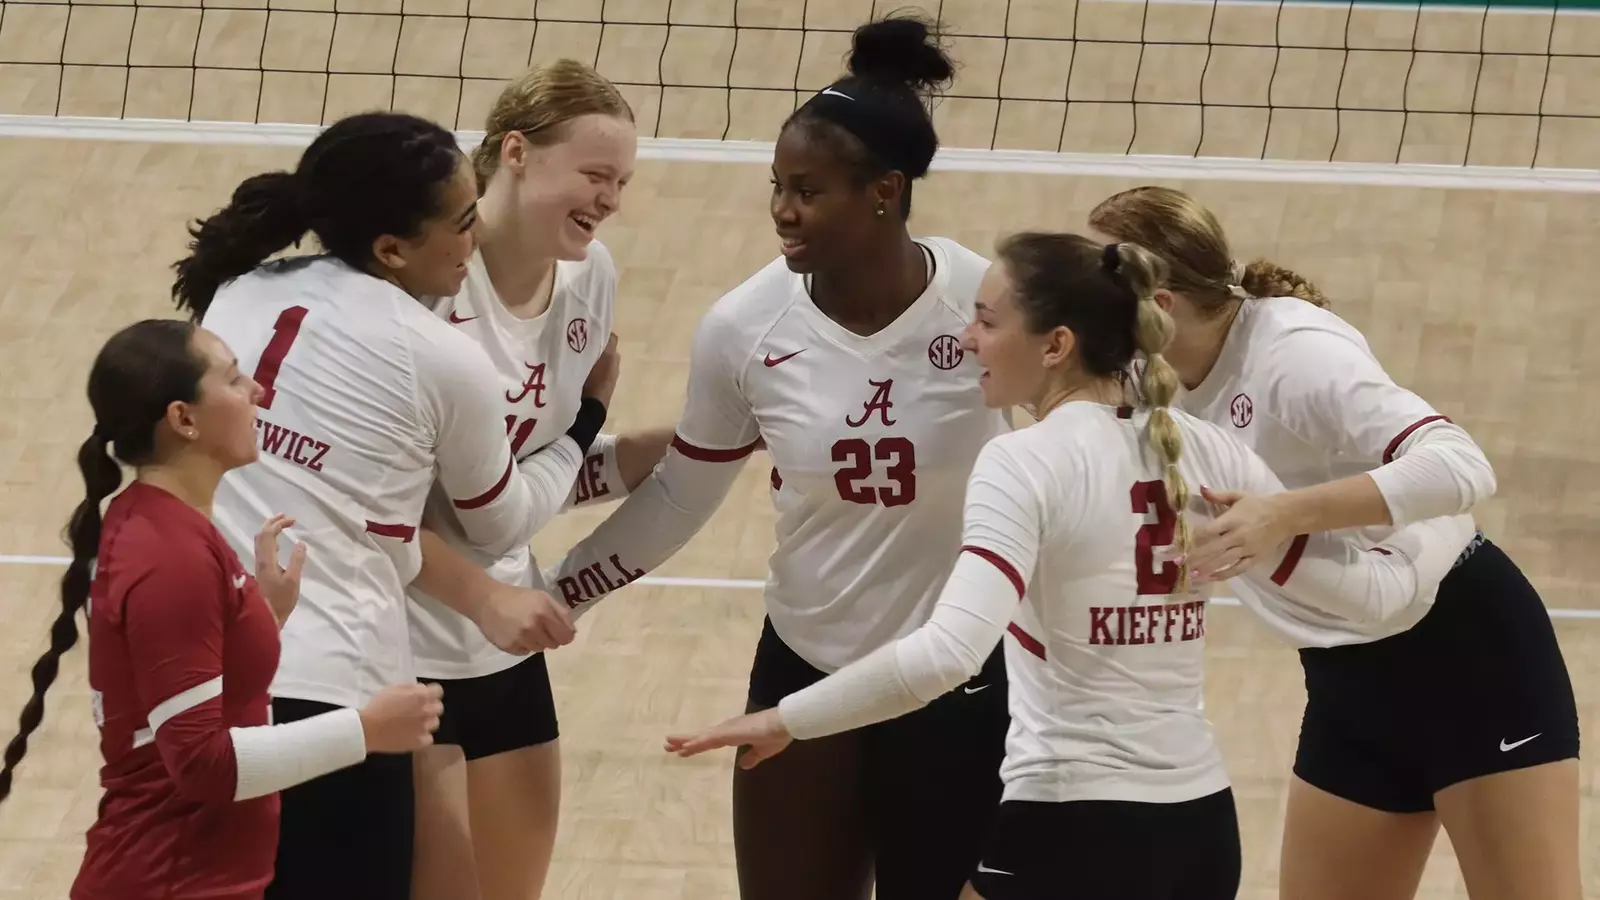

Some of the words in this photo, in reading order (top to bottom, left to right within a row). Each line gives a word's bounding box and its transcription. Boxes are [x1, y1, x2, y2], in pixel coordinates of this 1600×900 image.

[253, 305, 309, 410] 1
[929, 335, 964, 370] SEC
[506, 361, 546, 408] A
[846, 379, 896, 427] A
[256, 417, 331, 472] WICZ
[831, 437, 916, 507] 23
[1130, 480, 1183, 595] 2
[557, 554, 646, 609] ROLL
